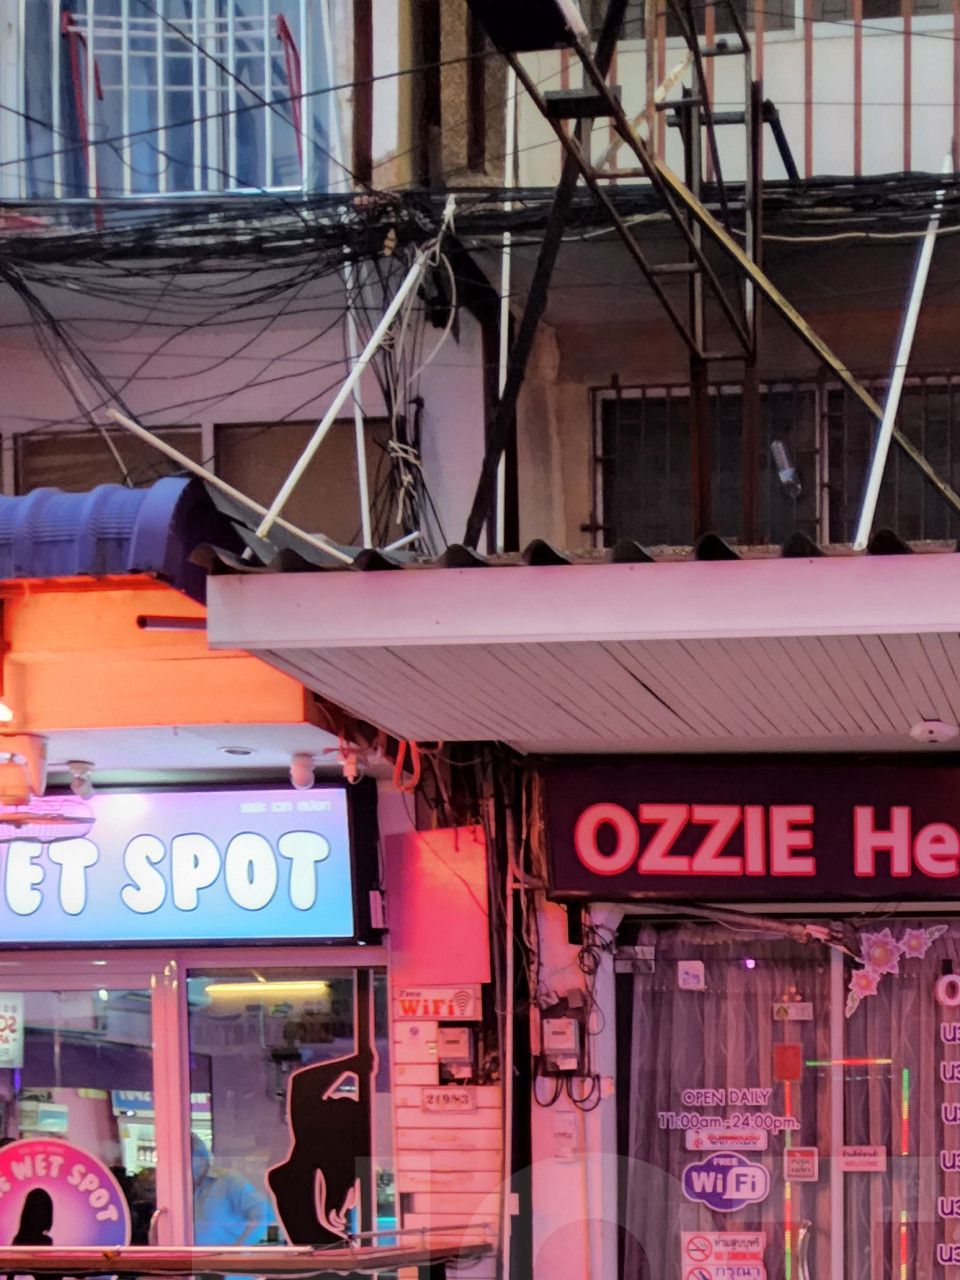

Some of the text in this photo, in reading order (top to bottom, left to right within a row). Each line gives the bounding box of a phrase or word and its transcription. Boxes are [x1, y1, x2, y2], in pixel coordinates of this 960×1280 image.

[121, 831, 331, 913] SPOT
[575, 803, 816, 877] OZZIE
[682, 1088, 772, 1106] OPEN DAILY
[11, 1154, 119, 1221] WET SPOT
